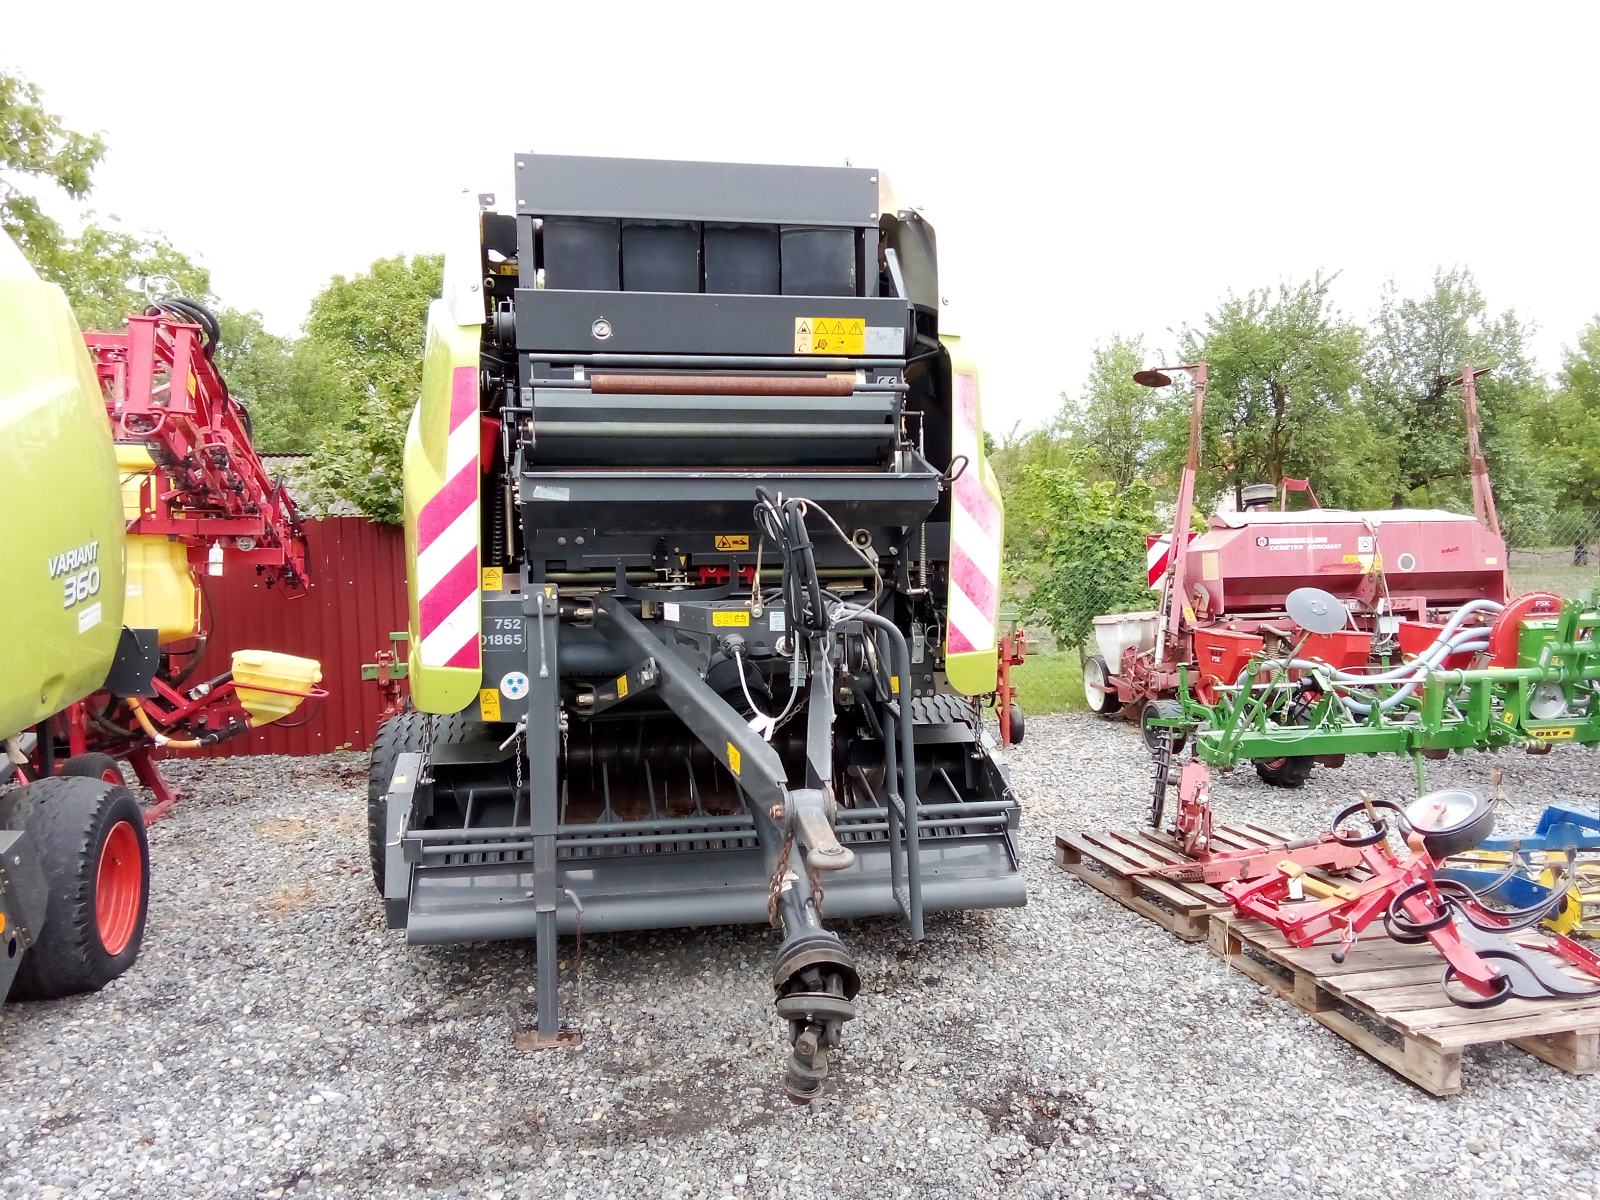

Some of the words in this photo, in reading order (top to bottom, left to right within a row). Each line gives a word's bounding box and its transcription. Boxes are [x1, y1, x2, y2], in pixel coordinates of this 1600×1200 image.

[48, 540, 99, 579] VARIANT
[63, 566, 101, 609] 360
[494, 618, 521, 630] 752
